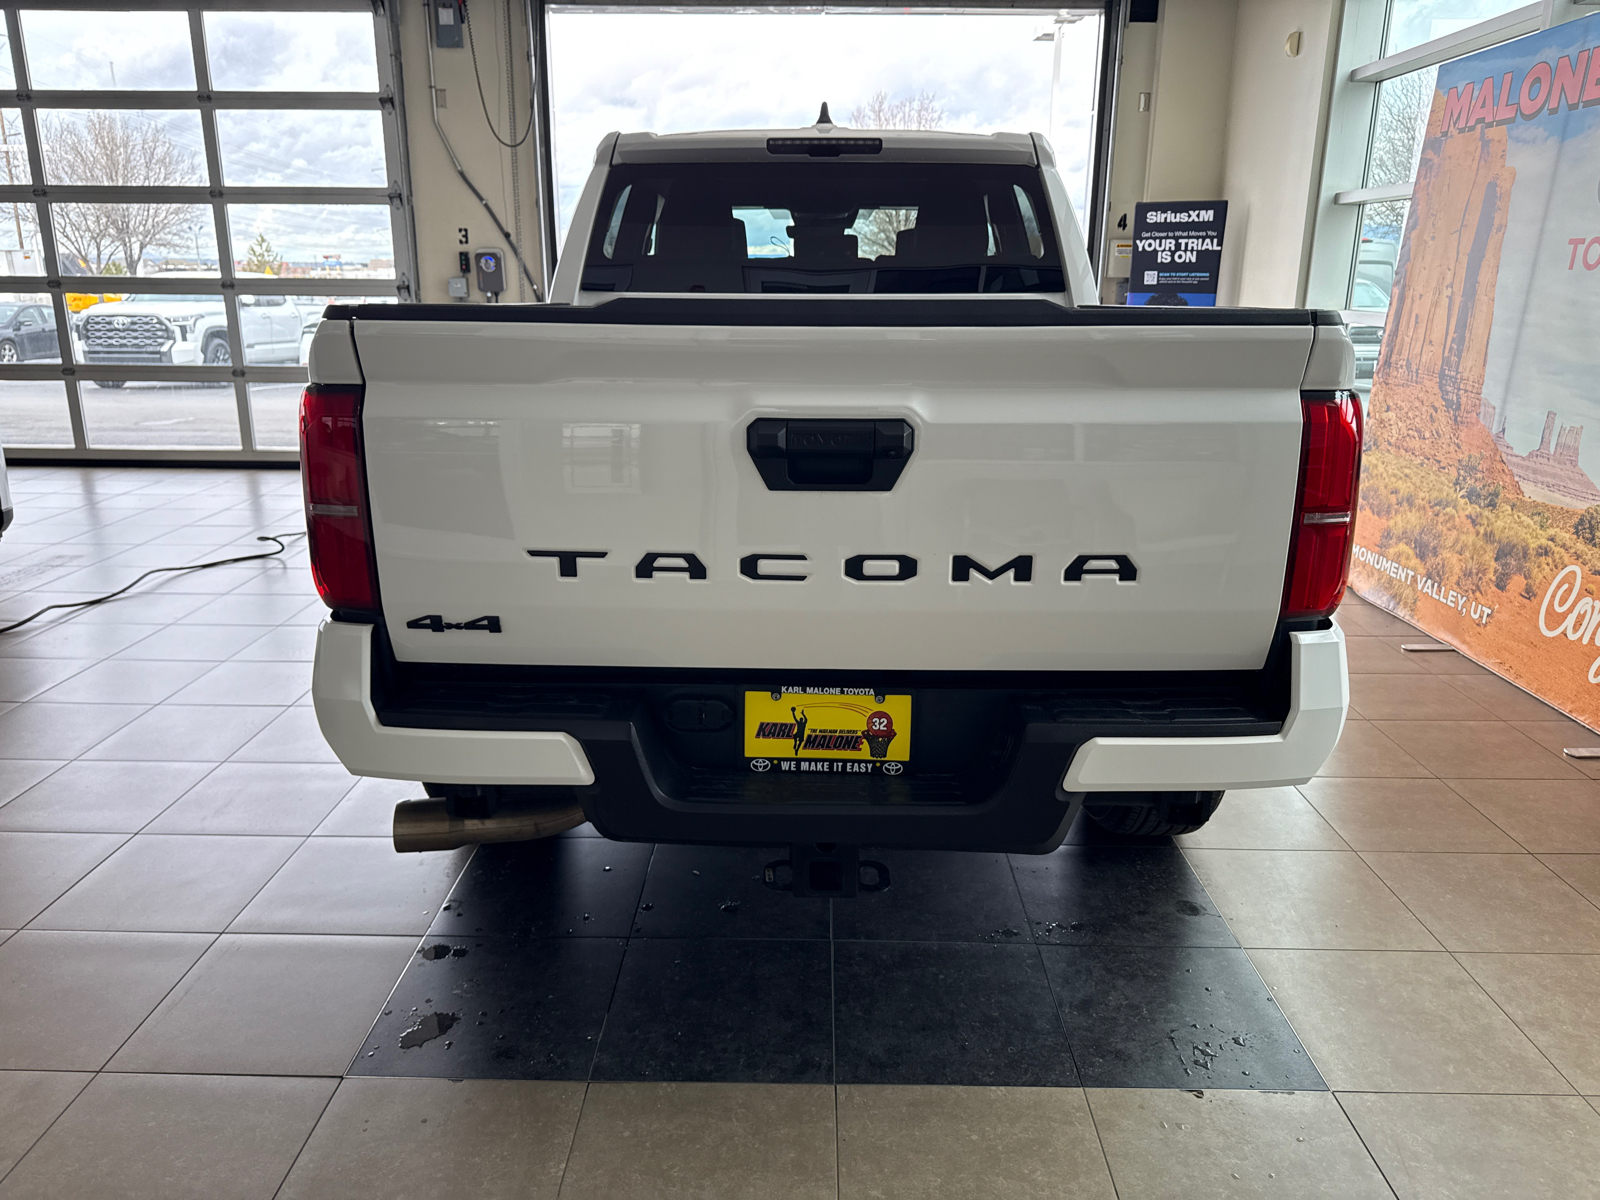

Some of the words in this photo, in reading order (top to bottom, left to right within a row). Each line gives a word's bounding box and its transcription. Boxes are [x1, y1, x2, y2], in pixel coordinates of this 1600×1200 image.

[1117, 213, 1128, 231] 4
[1146, 209, 1214, 223] SiriusXM
[458, 228, 469, 244] 3
[1135, 238, 1176, 252] YOUR
[1178, 238, 1222, 251] TRIAL
[1157, 251, 1172, 263] IS
[1174, 250, 1197, 263] ON
[525, 549, 1139, 582] TACOMA
[1352, 543, 1415, 585] MONUMENT
[1417, 574, 1467, 617] VALLEY,
[1470, 601, 1492, 625] UT
[406, 614, 502, 633] 4x4
[781, 685, 804, 694] KARL
[806, 686, 841, 695] MALONE
[843, 688, 875, 696] TOYOTA
[755, 721, 797, 740] KARL
[872, 717, 888, 731] 32
[802, 734, 864, 751] MALONE
[780, 761, 797, 771] WE
[800, 761, 830, 772] MAKE
[833, 762, 843, 772] IT
[846, 762, 873, 773] EASY
